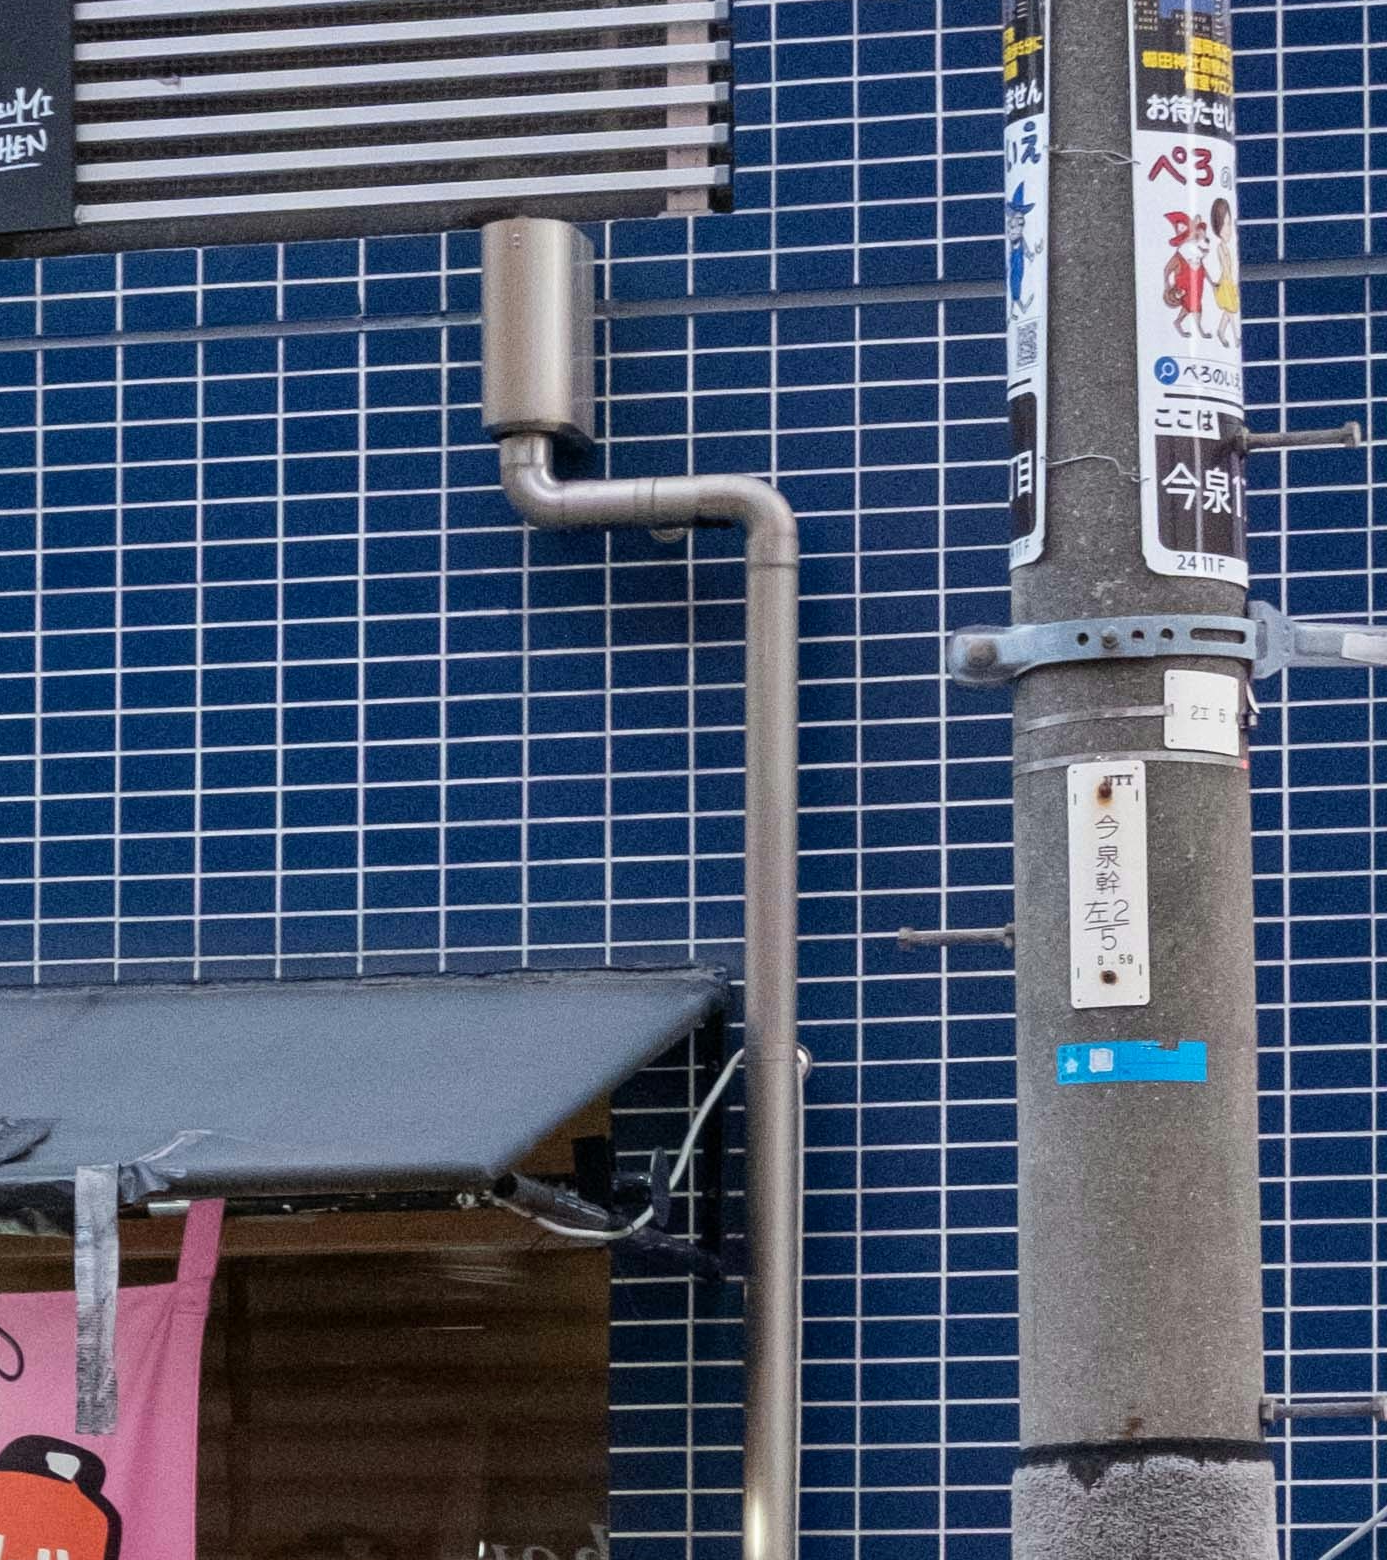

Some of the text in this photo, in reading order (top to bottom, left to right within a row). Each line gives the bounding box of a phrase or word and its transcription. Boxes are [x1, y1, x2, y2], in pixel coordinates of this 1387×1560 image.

[1154, 407, 1214, 433] ここは
[1094, 813, 1121, 894] 今泉幹
